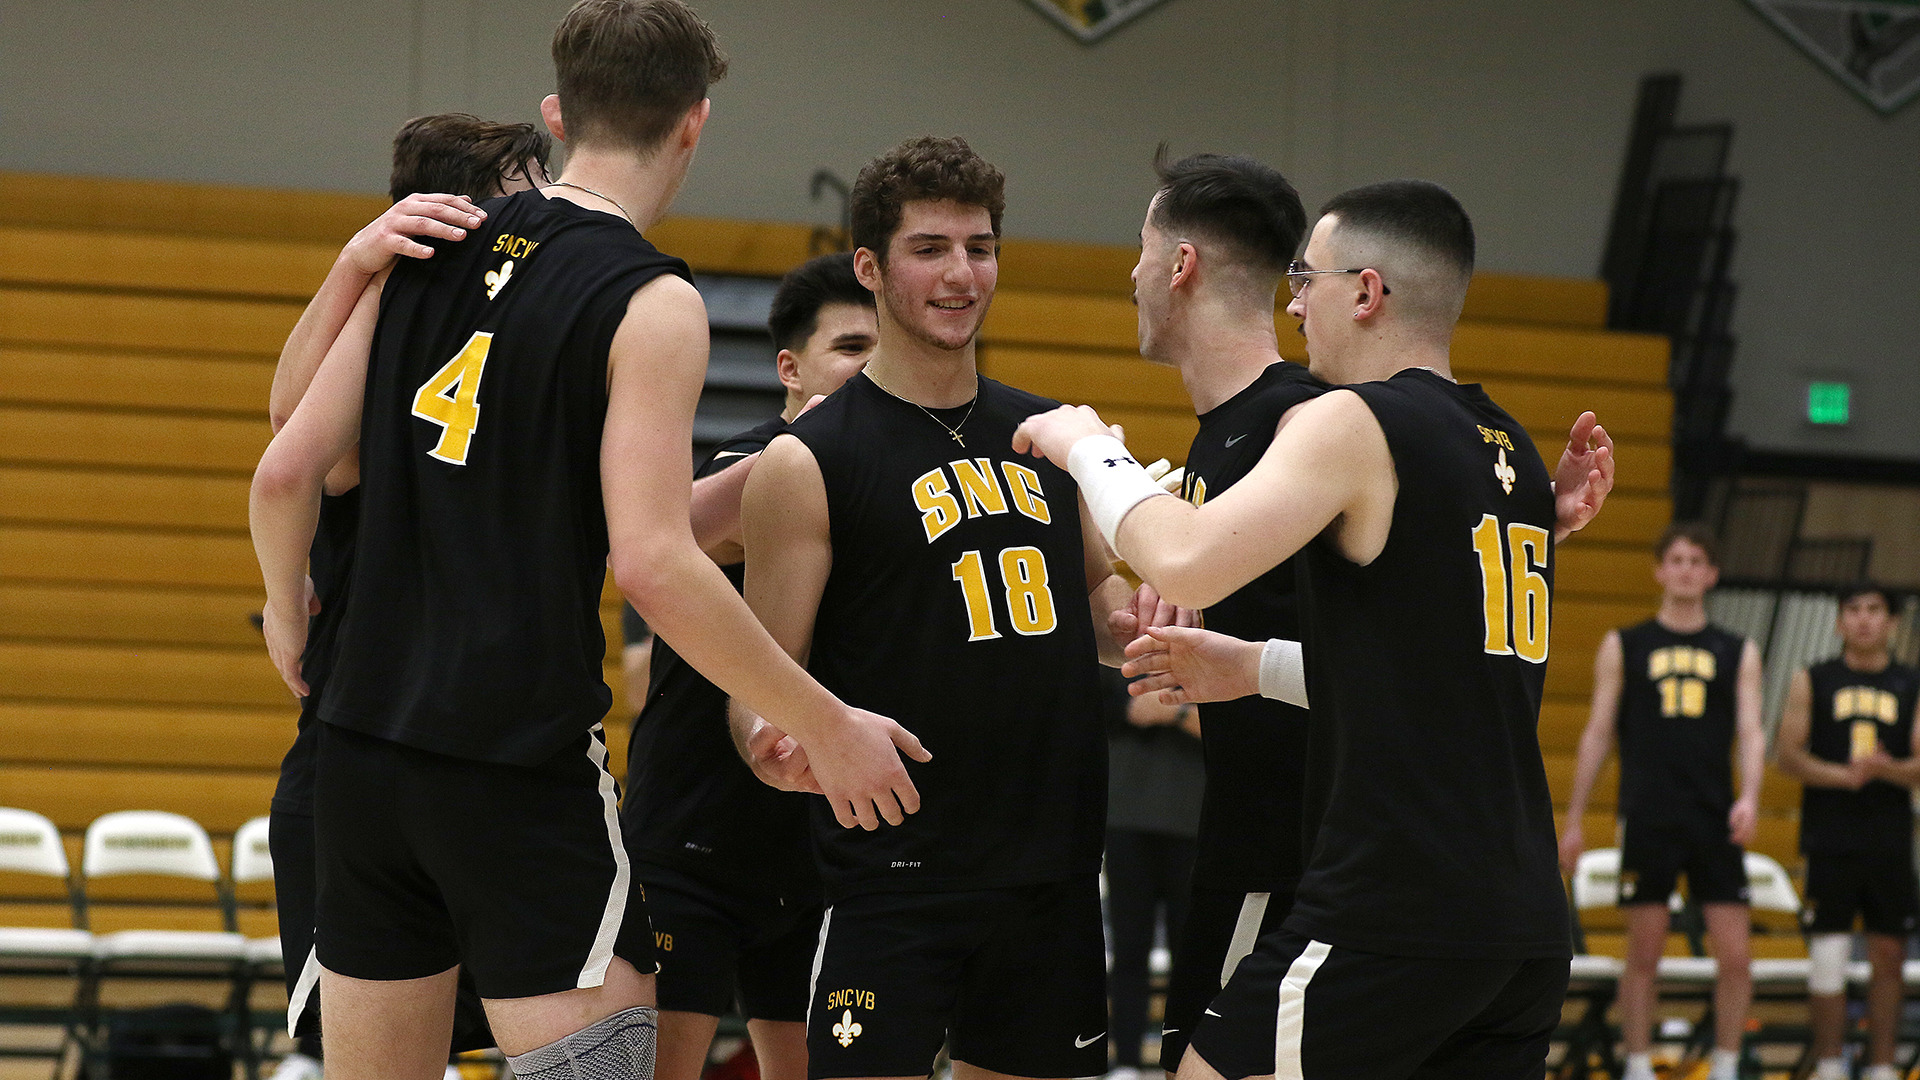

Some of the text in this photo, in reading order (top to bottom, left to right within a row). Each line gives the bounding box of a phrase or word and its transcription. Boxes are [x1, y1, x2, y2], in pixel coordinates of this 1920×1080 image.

[411, 330, 494, 466] 4
[911, 457, 1052, 545] SNC
[951, 546, 1058, 642] 18
[1471, 513, 1549, 664] 16
[827, 988, 875, 1011] SNCVB
